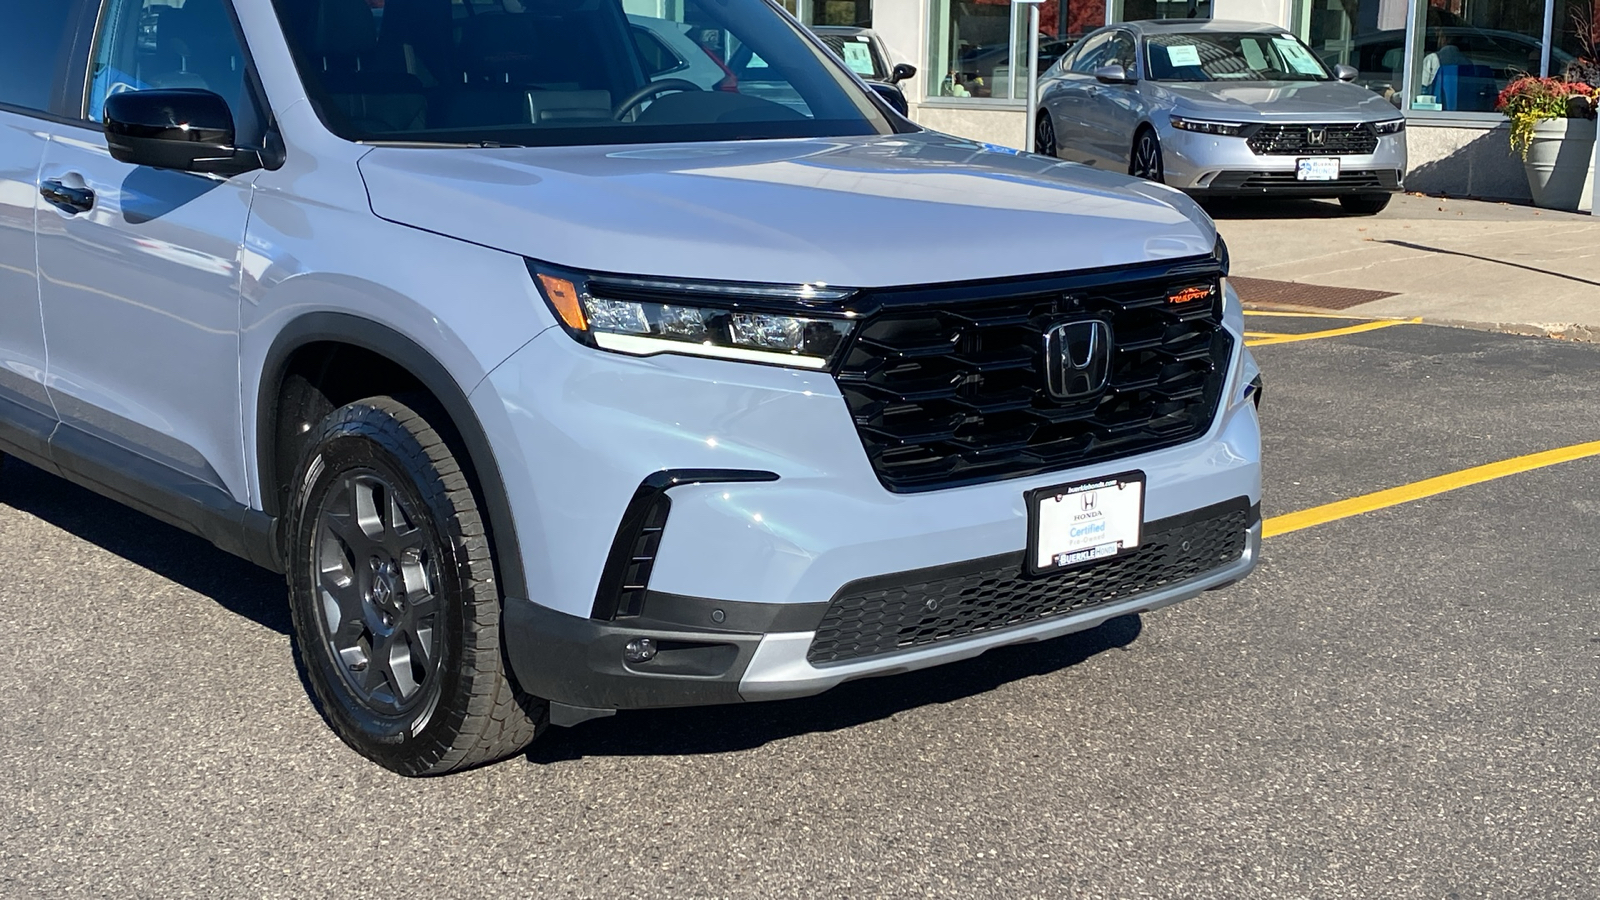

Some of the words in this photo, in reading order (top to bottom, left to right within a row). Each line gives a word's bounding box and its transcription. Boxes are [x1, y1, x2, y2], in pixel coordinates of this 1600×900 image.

[1073, 510, 1103, 521] HONDA
[1069, 521, 1106, 538] Certified
[1069, 533, 1106, 546] Pre-Owned
[1060, 548, 1095, 565] BUERKLE
[1096, 545, 1116, 557] HONDA
